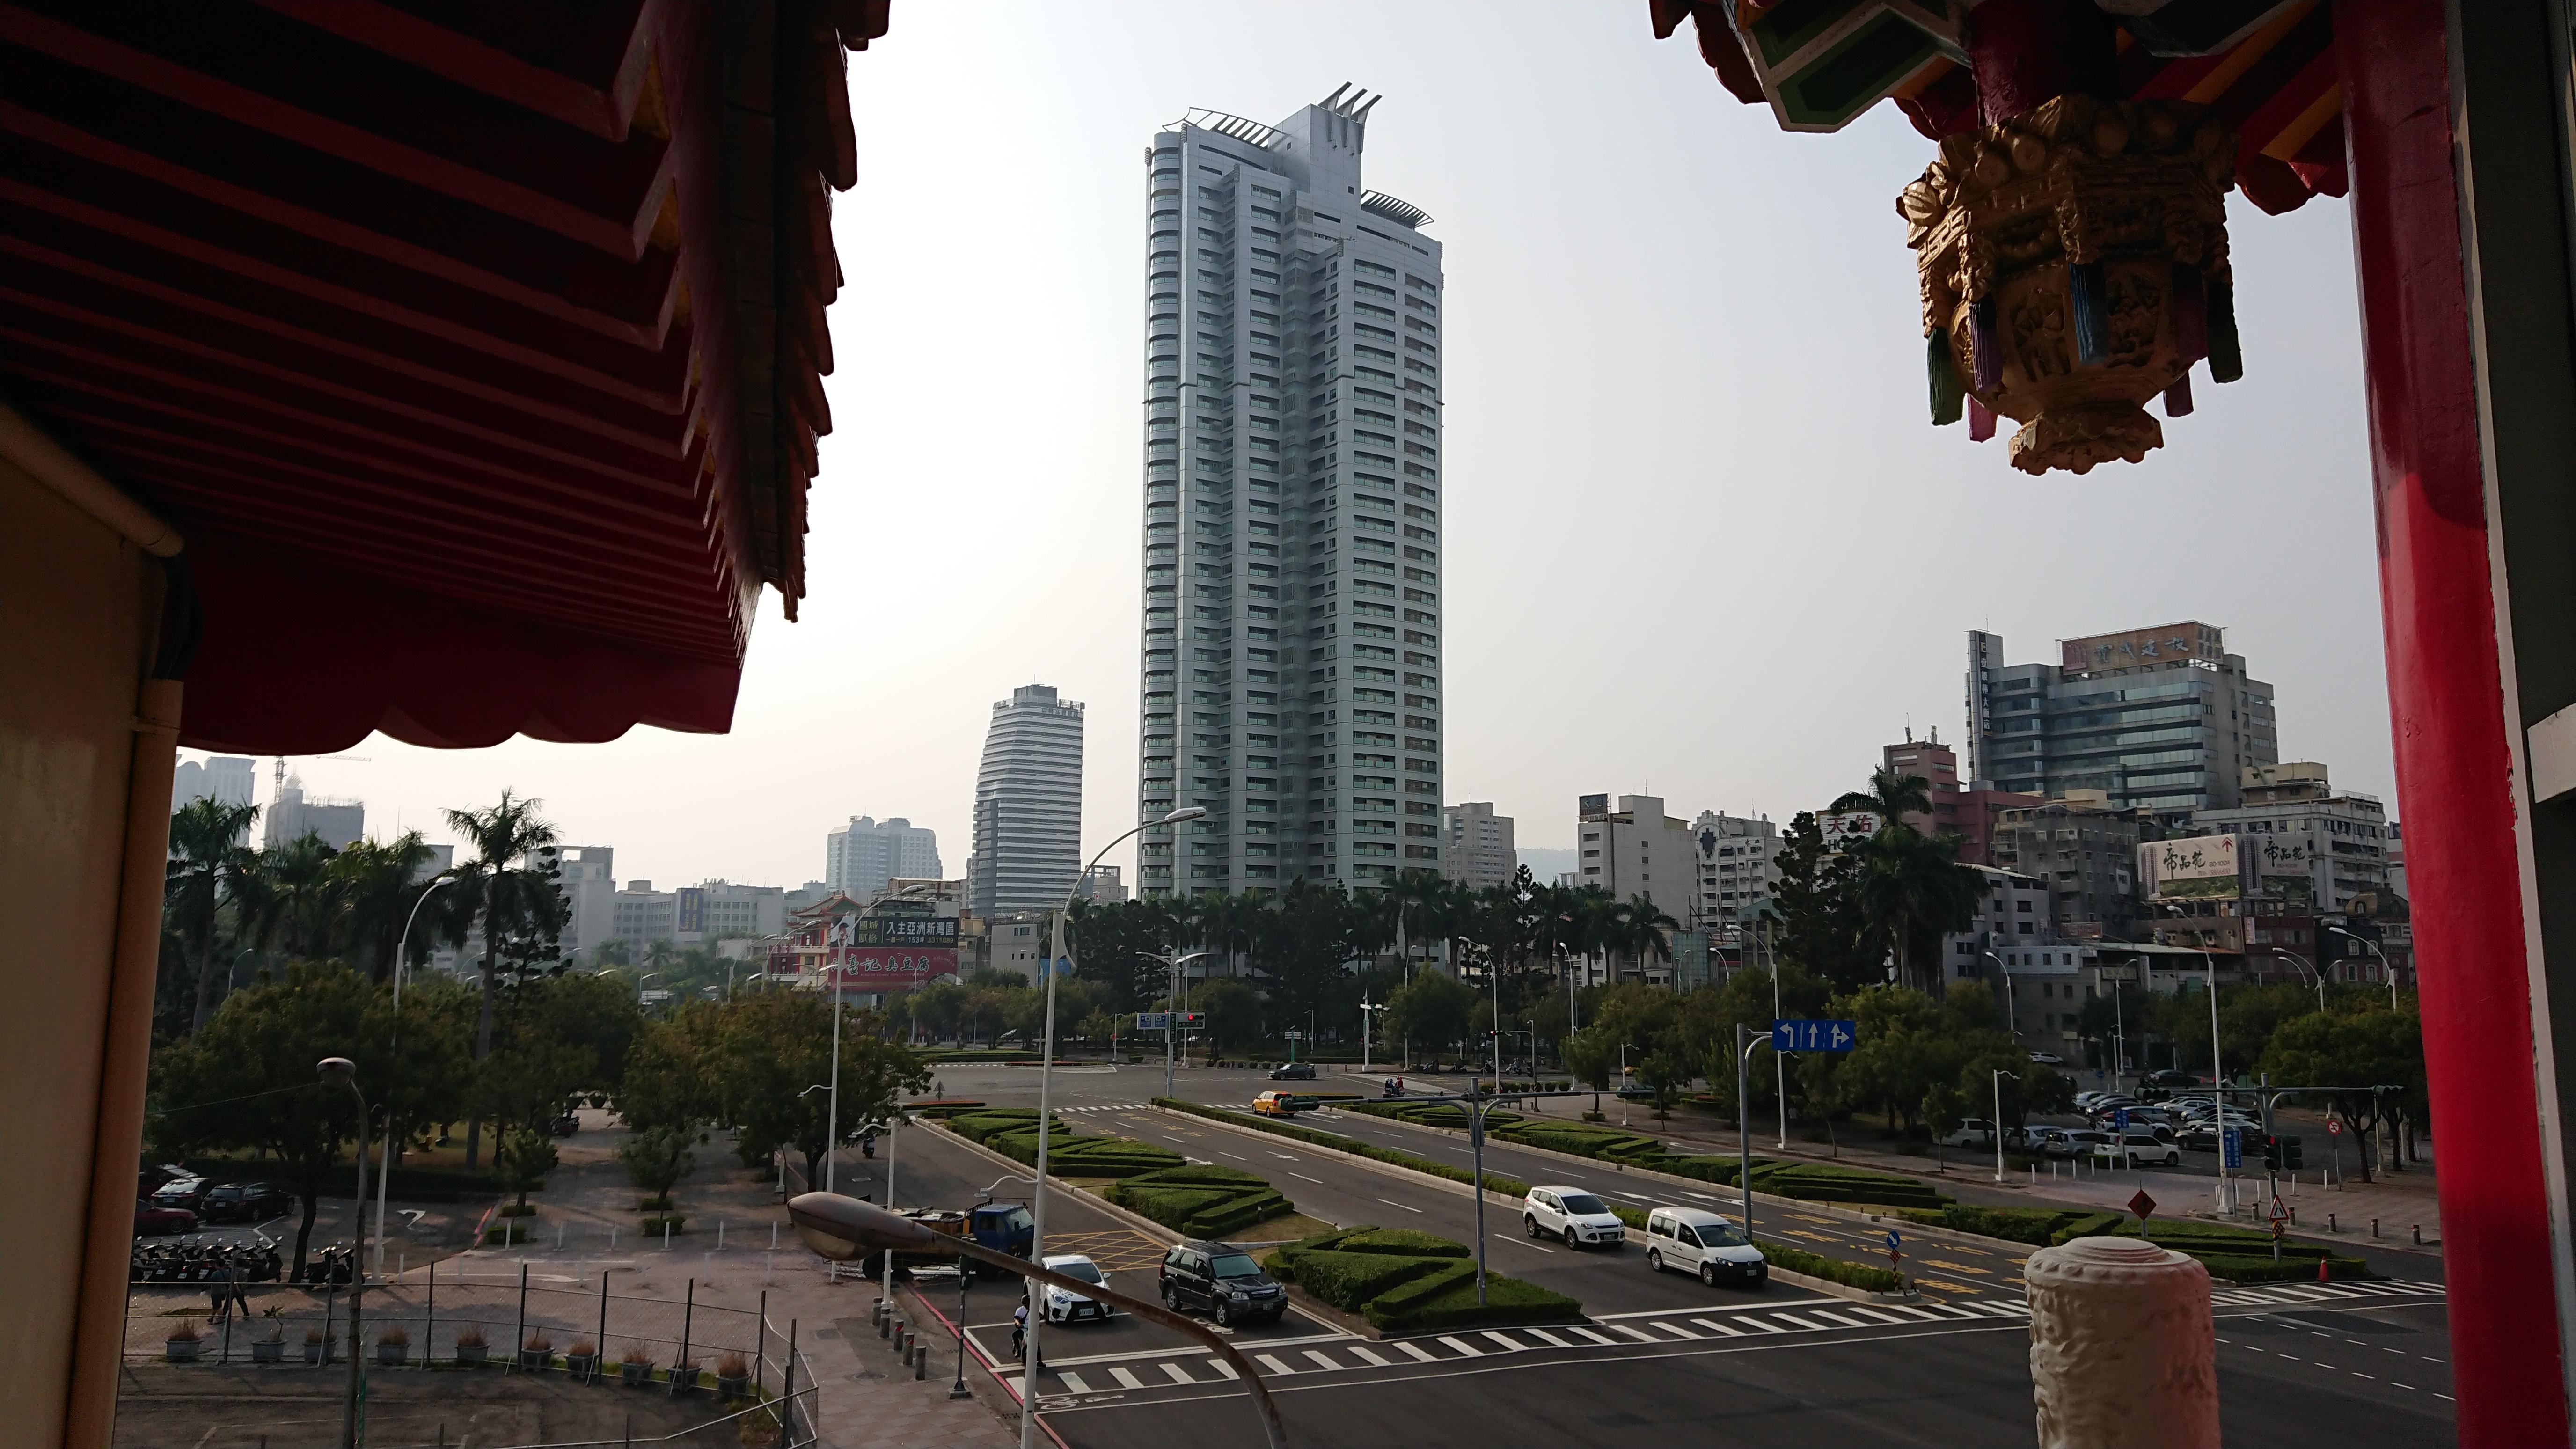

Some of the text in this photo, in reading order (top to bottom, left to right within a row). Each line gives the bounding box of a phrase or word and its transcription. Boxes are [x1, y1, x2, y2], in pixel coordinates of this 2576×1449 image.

[886, 921, 955, 936] 入主亞洲新灣區
